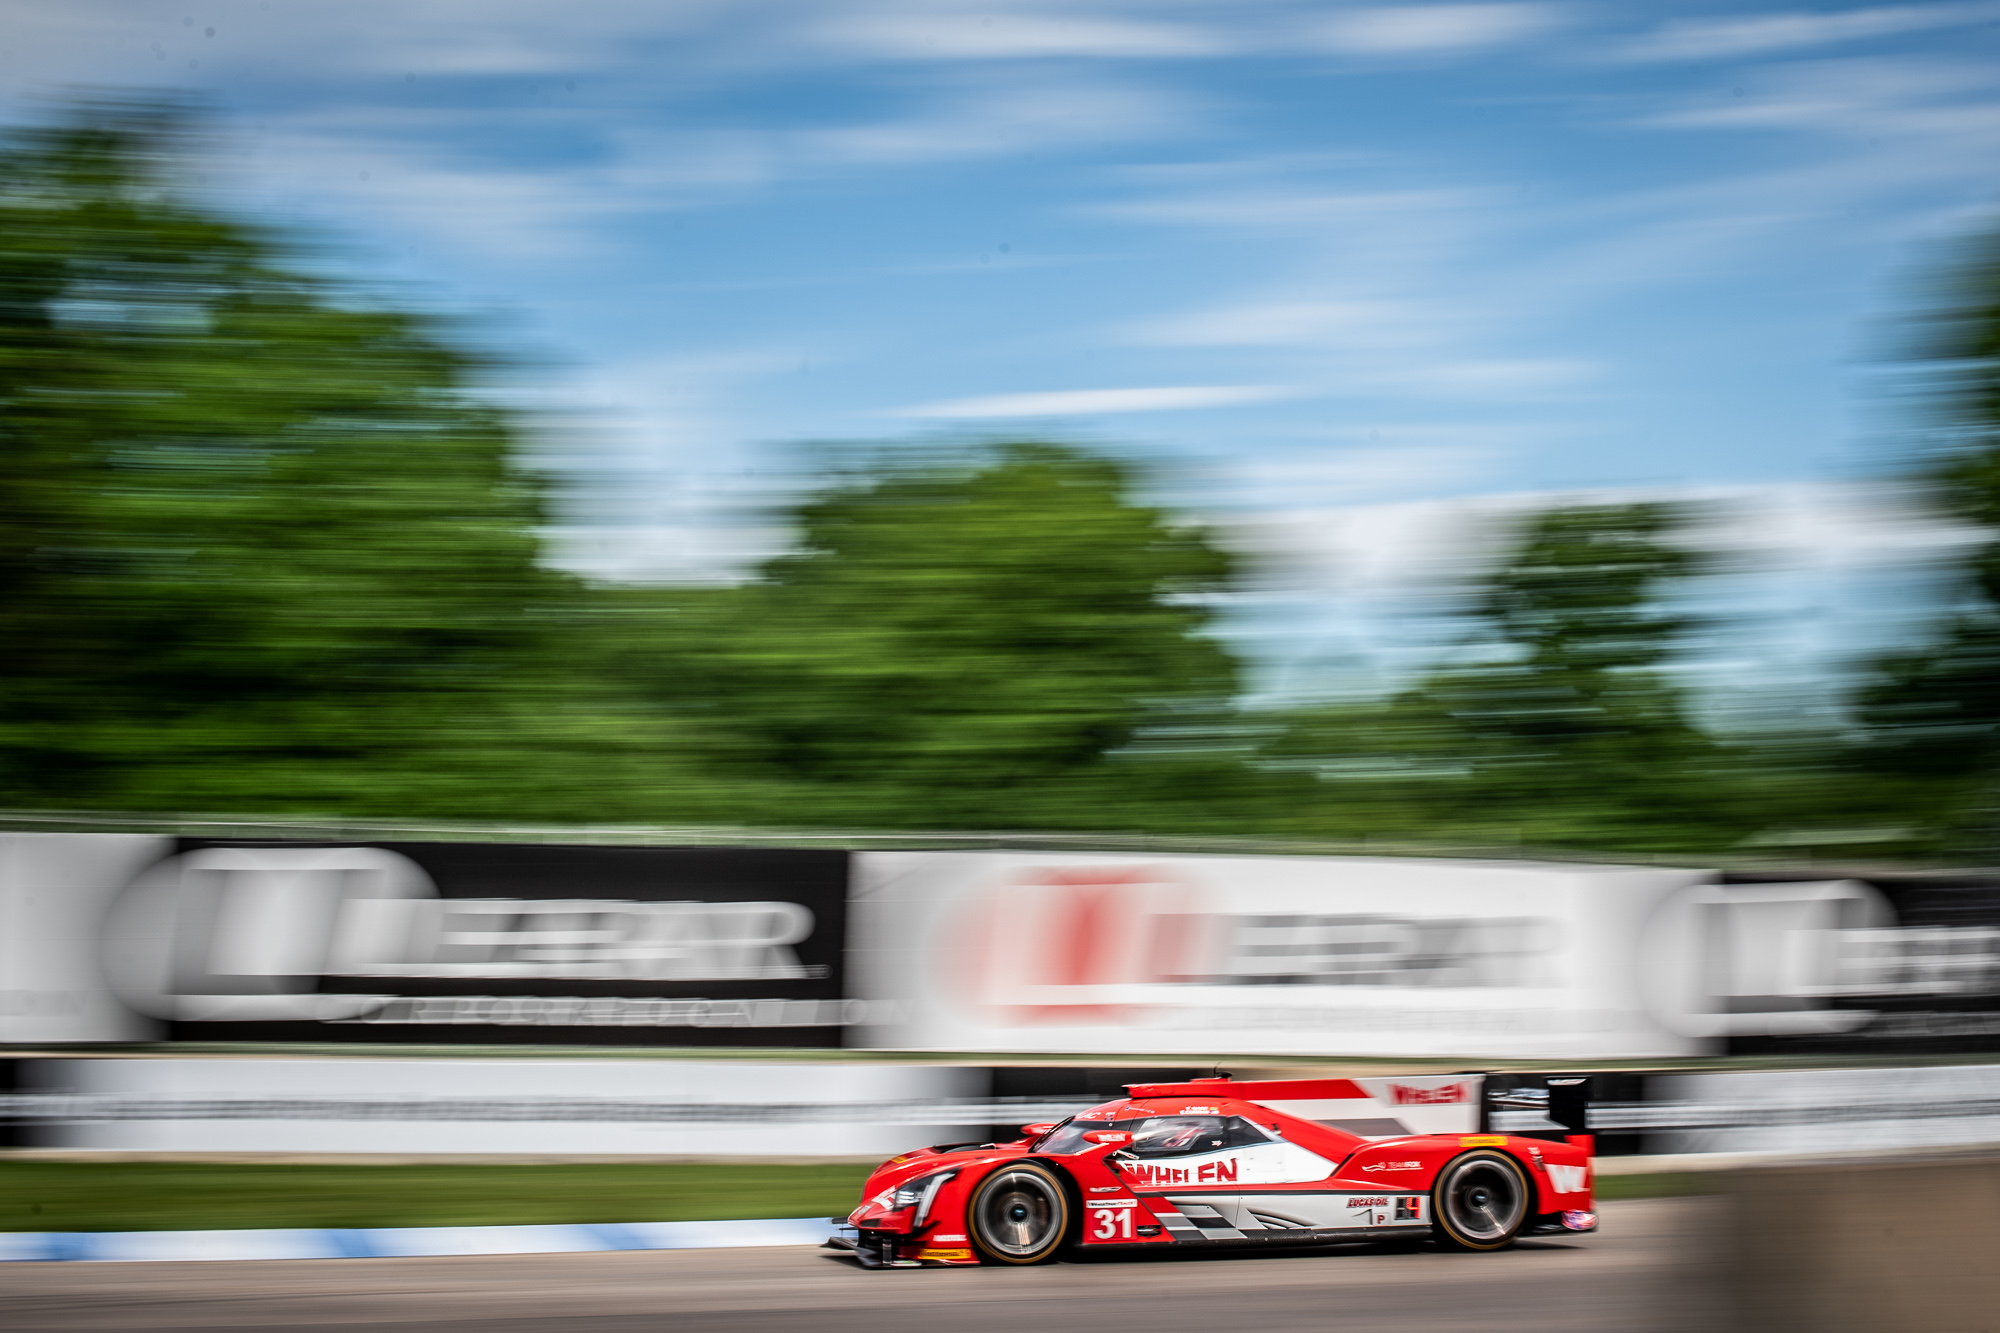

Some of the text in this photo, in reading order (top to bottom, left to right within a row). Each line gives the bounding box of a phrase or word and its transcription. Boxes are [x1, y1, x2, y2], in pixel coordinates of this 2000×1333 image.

[1346, 1196, 1389, 1208] LUCAS OIL
[1093, 1208, 1132, 1239] 31
